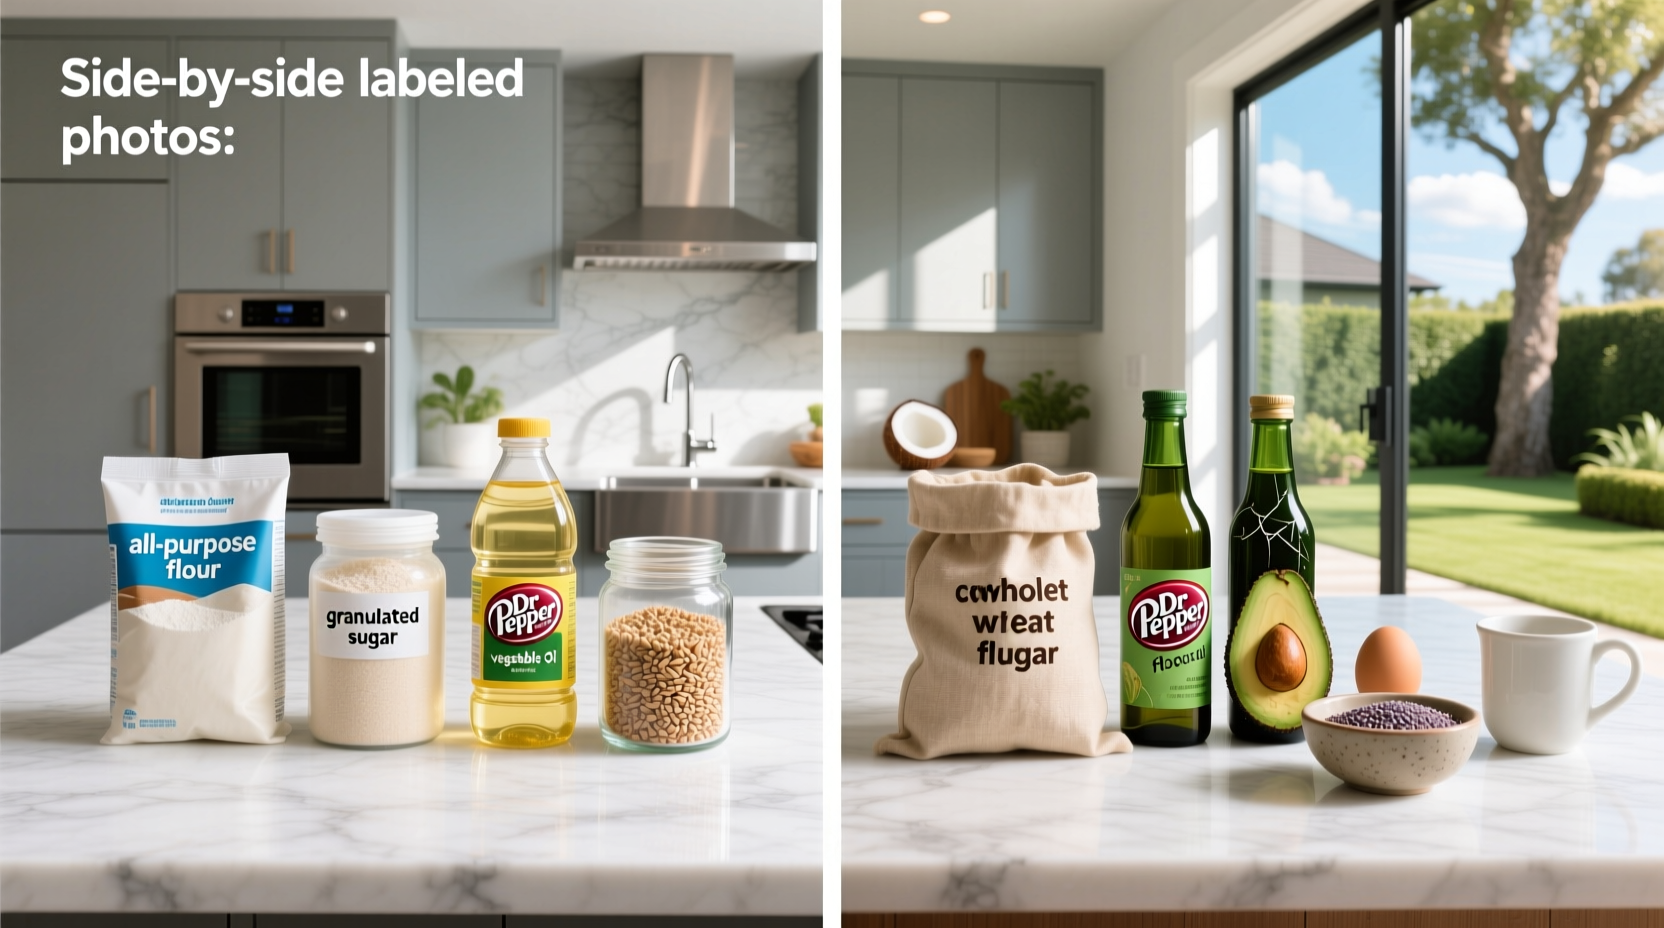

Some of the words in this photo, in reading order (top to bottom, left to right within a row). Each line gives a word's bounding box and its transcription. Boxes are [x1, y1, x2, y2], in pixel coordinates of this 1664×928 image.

[128, 532, 257, 560] all-purpose
[165, 557, 222, 580] flour
[512, 593, 540, 616] Dr
[1158, 591, 1188, 617] Dr
[326, 606, 420, 629] granulated
[496, 598, 556, 637] Pepper
[1139, 597, 1204, 640] Pepper
[348, 631, 399, 650] sugar
[976, 640, 1059, 672] flugar
